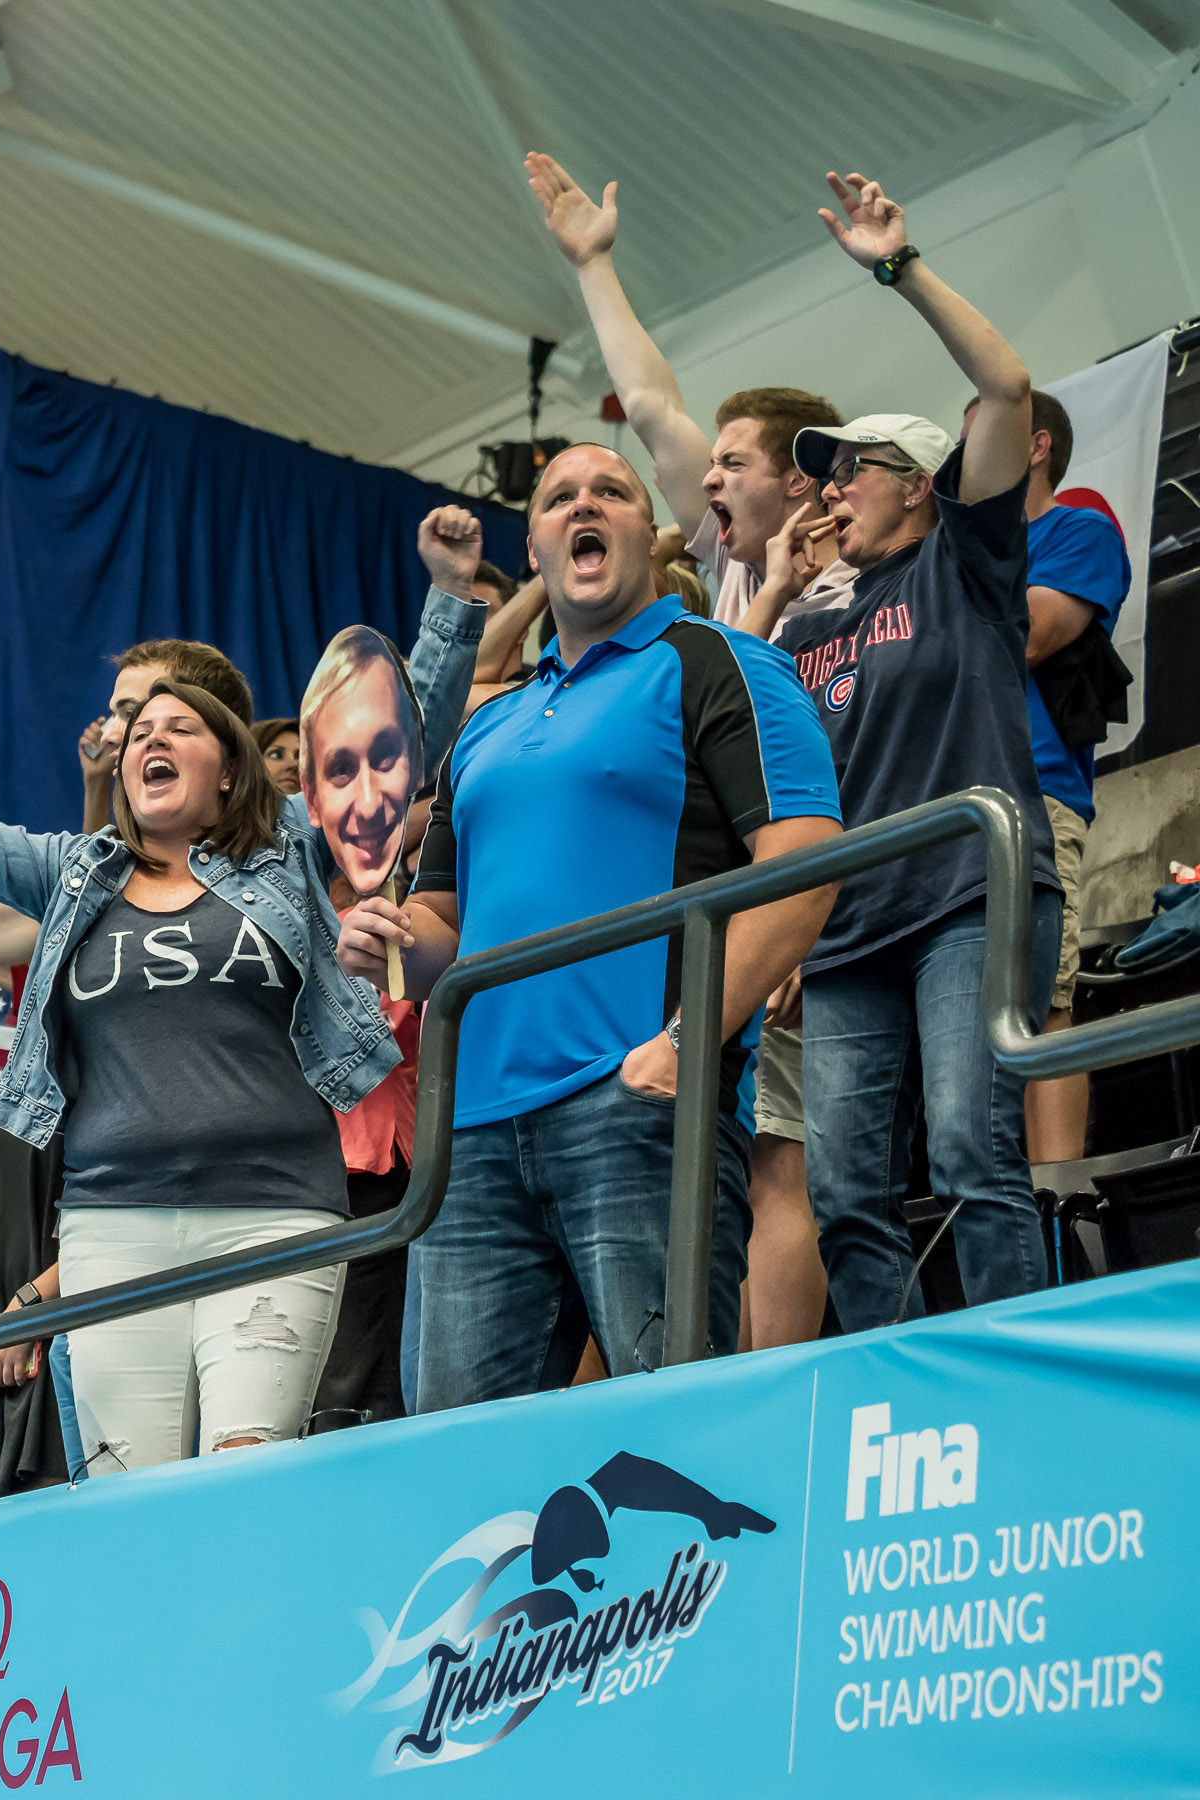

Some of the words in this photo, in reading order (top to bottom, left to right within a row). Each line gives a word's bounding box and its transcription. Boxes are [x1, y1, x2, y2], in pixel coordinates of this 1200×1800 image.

[68, 915, 285, 1001] USA
[843, 1533, 980, 1595] WORLD
[989, 1509, 1144, 1577] JUNIOR
[395, 1541, 725, 1759] Indianapolis
[838, 1592, 1046, 1664] SWIMMING
[598, 1649, 673, 1706] 2017
[834, 1650, 1163, 1732] CHAMPIONSHIPS
